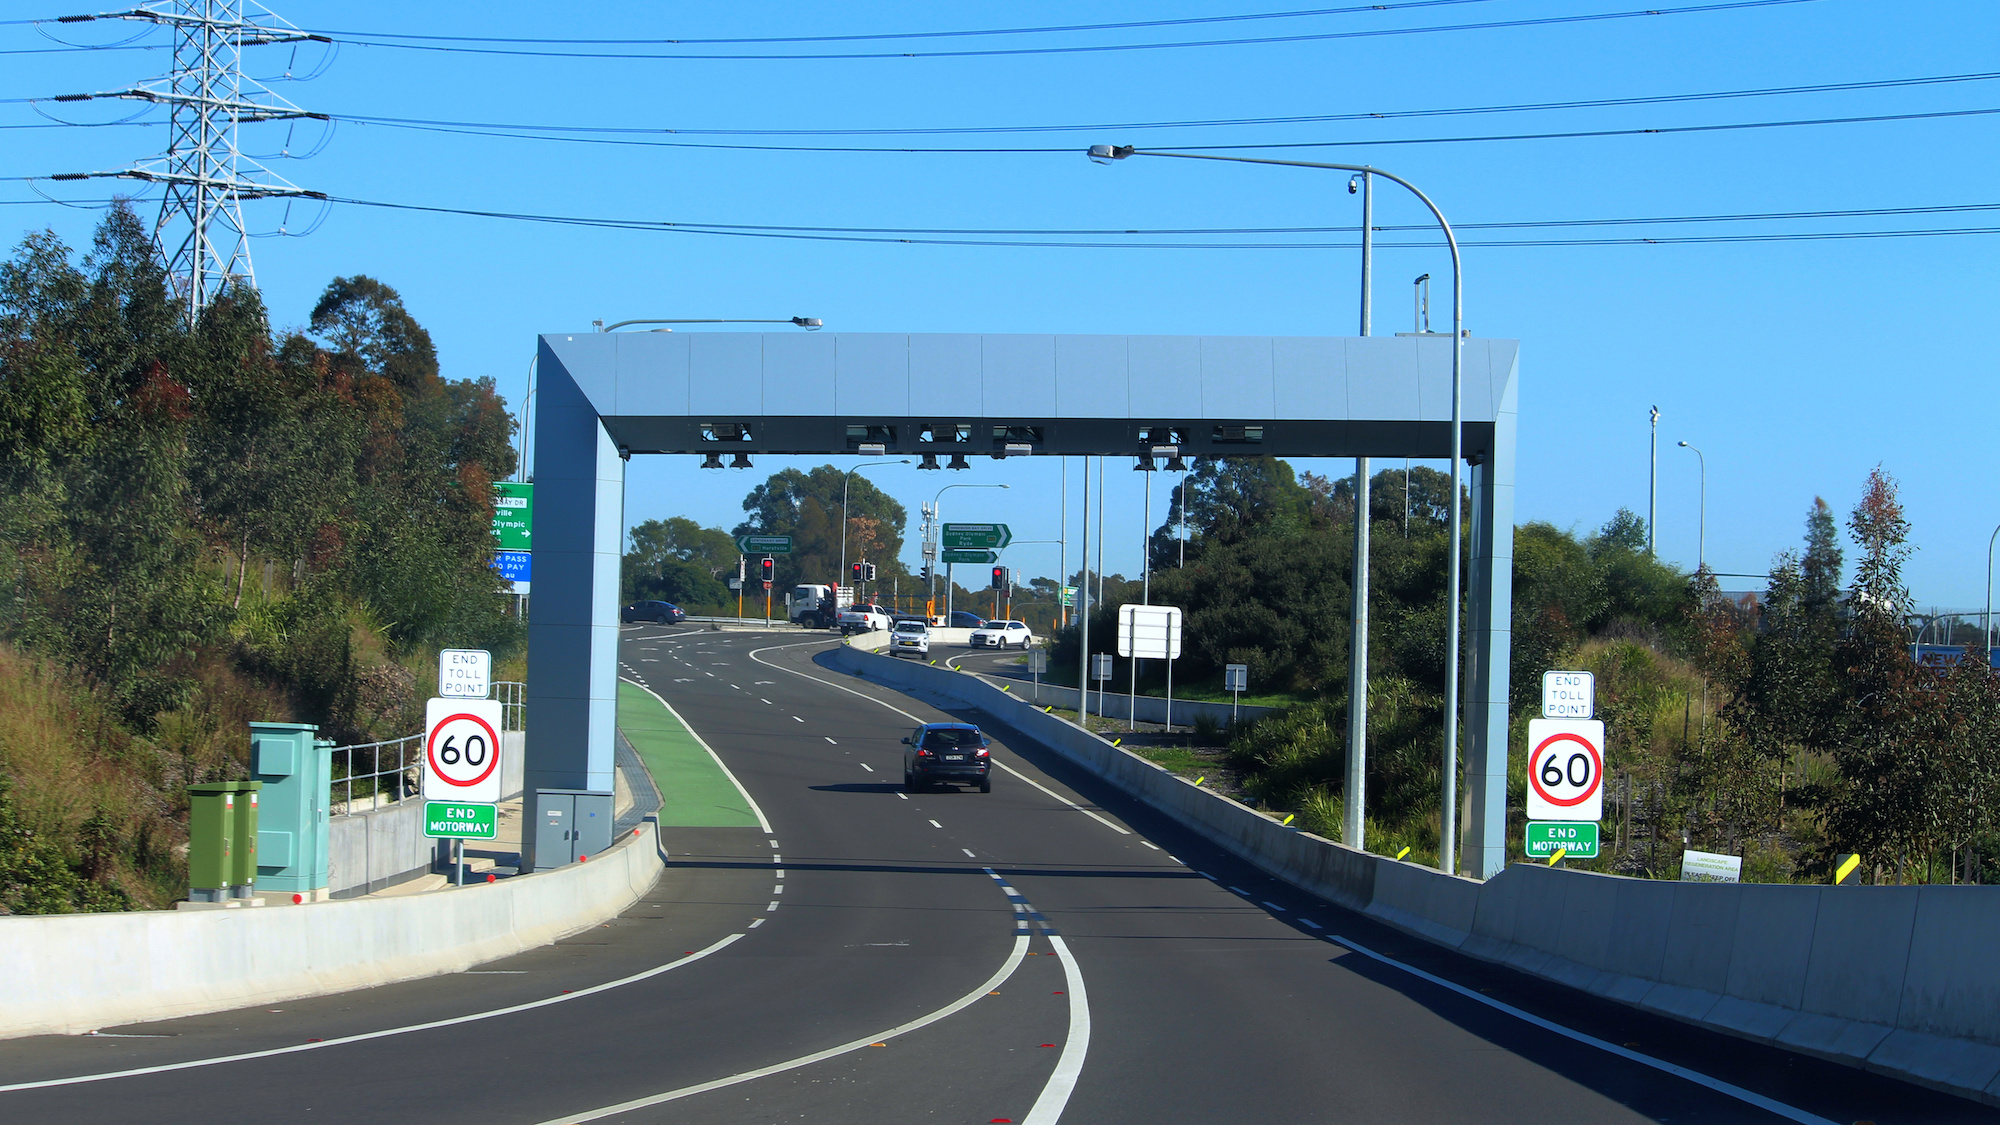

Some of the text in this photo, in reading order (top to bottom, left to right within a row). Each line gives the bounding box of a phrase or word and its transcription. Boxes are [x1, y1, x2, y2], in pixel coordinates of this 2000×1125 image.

[492, 520, 525, 528] Olympic
[452, 655, 478, 664] END
[449, 669, 481, 679] TOLL
[1555, 676, 1581, 686] END
[445, 683, 483, 693] POINT
[1552, 690, 1584, 700] TOLL
[1549, 704, 1587, 714] POINT
[441, 735, 486, 766] 60
[1541, 753, 1590, 787] 60
[446, 808, 476, 819] END
[430, 821, 490, 833] MOTORWAY
[1548, 828, 1577, 838] END
[1532, 841, 1592, 852] MOTORWAY
[1685, 861, 1724, 870] REGENERATION
[1697, 857, 1728, 865] LANDSCAPE
